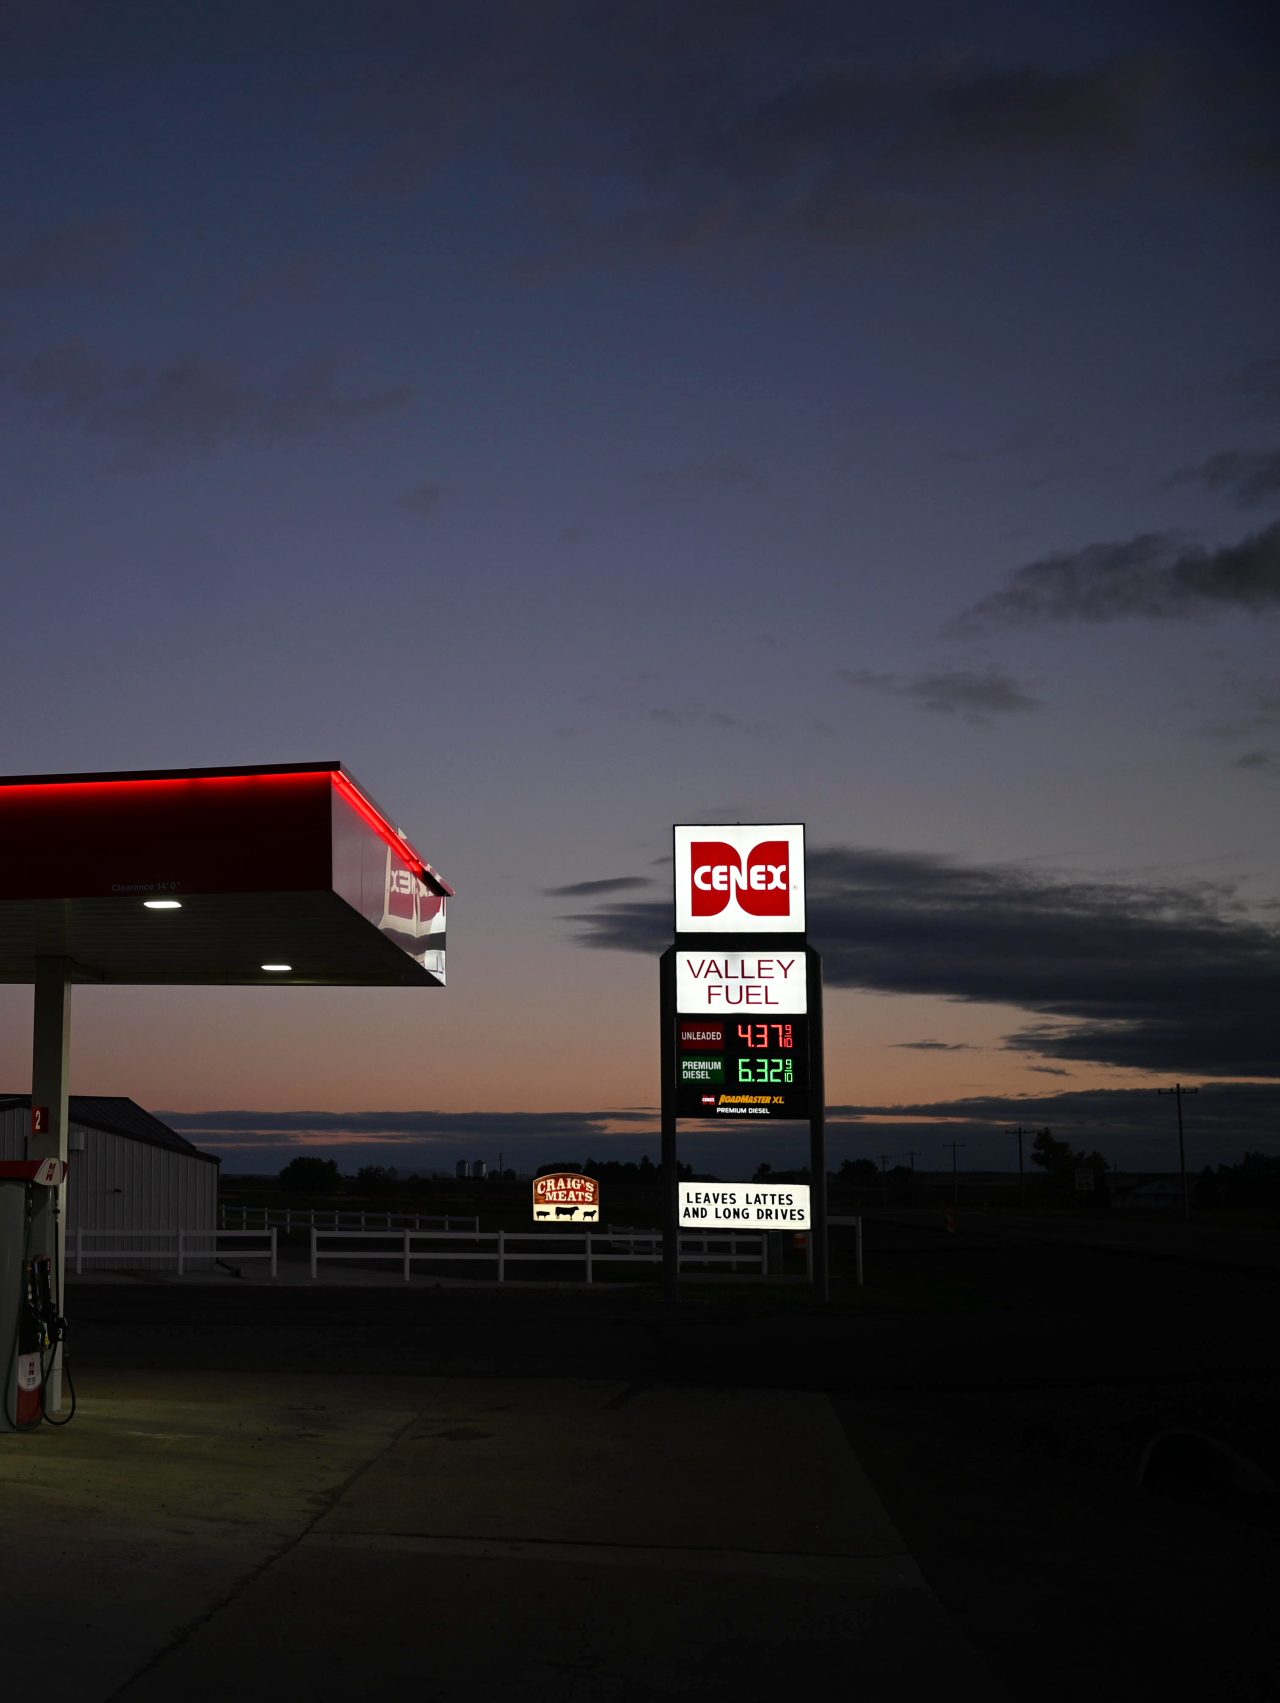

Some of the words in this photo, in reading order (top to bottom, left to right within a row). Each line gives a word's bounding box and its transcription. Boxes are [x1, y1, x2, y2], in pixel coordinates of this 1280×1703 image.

[694, 864, 786, 891] CENEX
[687, 959, 795, 979] VALLEY
[707, 985, 779, 1005] FUEL
[681, 1031, 721, 1040] UNLEADED
[738, 1024, 783, 1048] 4.37
[682, 1061, 721, 1070] PREMIUM
[738, 1058, 783, 1082] 6.32
[682, 1070, 711, 1079] DIESEL
[772, 1096, 784, 1104] XL
[35, 1110, 41, 1130] 2
[537, 1177, 594, 1194] CRAIG'S
[545, 1190, 593, 1202] MEATS
[686, 1192, 736, 1204] LEAVES
[745, 1193, 793, 1205] LATTES
[683, 1207, 708, 1218] AND
[715, 1207, 750, 1219] LONG
[756, 1208, 805, 1221] DRIVES
